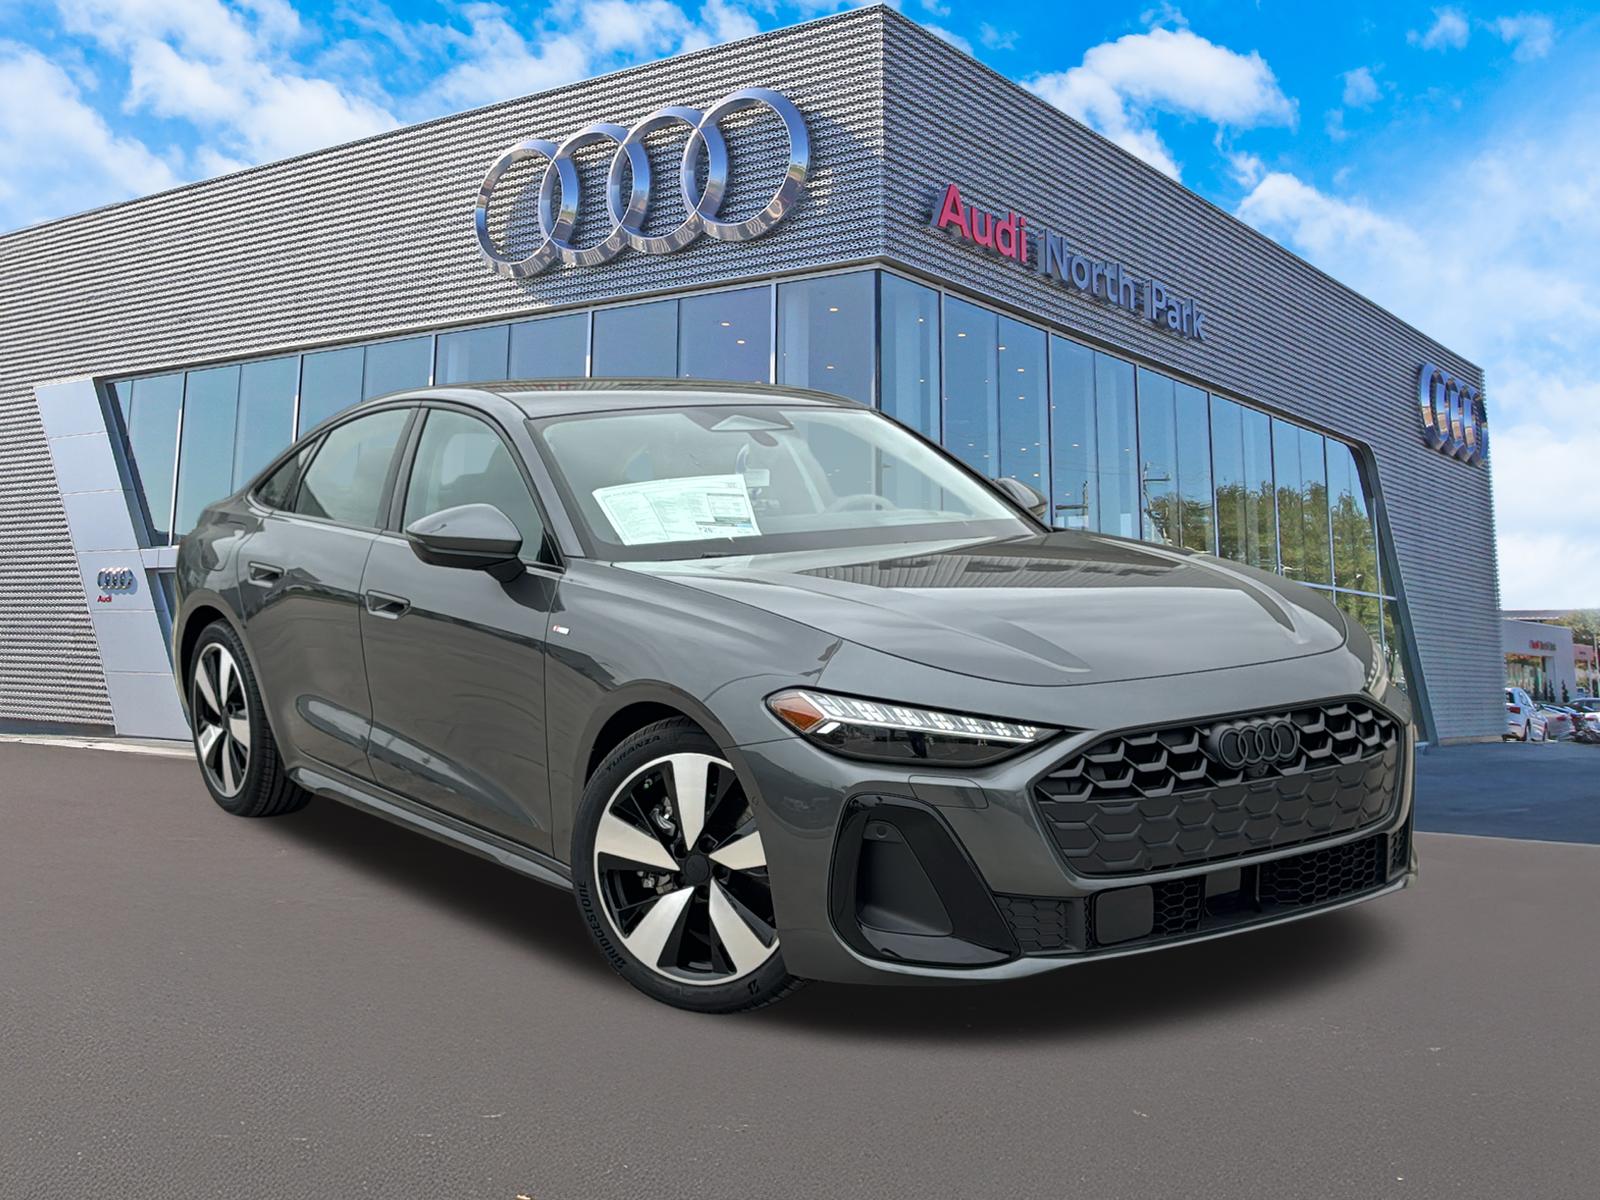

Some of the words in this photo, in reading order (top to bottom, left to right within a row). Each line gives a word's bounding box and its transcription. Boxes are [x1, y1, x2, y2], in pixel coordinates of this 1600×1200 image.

[933, 183, 1028, 263] Audi
[1038, 229, 1136, 311] North
[1145, 278, 1206, 341] Park
